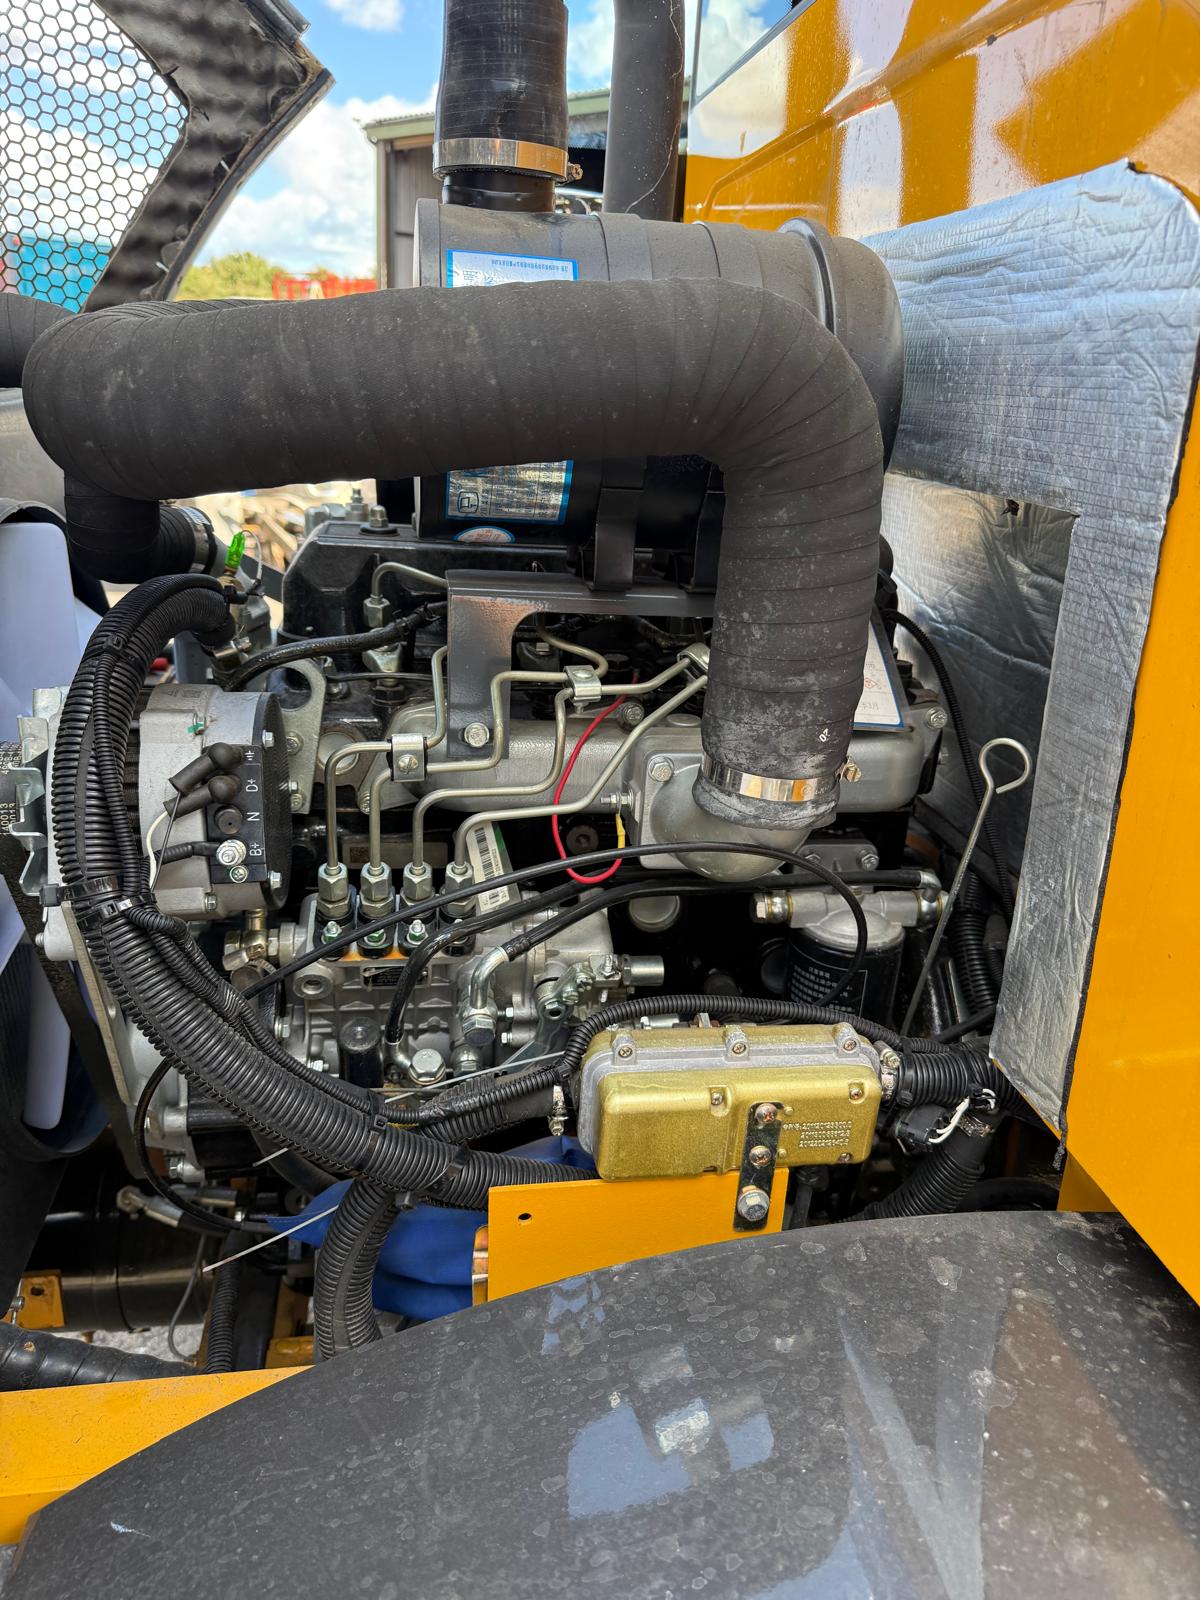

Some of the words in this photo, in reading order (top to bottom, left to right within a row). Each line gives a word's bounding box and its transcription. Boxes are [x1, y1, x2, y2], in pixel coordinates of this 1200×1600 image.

[245, 778, 259, 792] D+
[246, 812, 260, 821] N
[249, 842, 262, 856] B+
